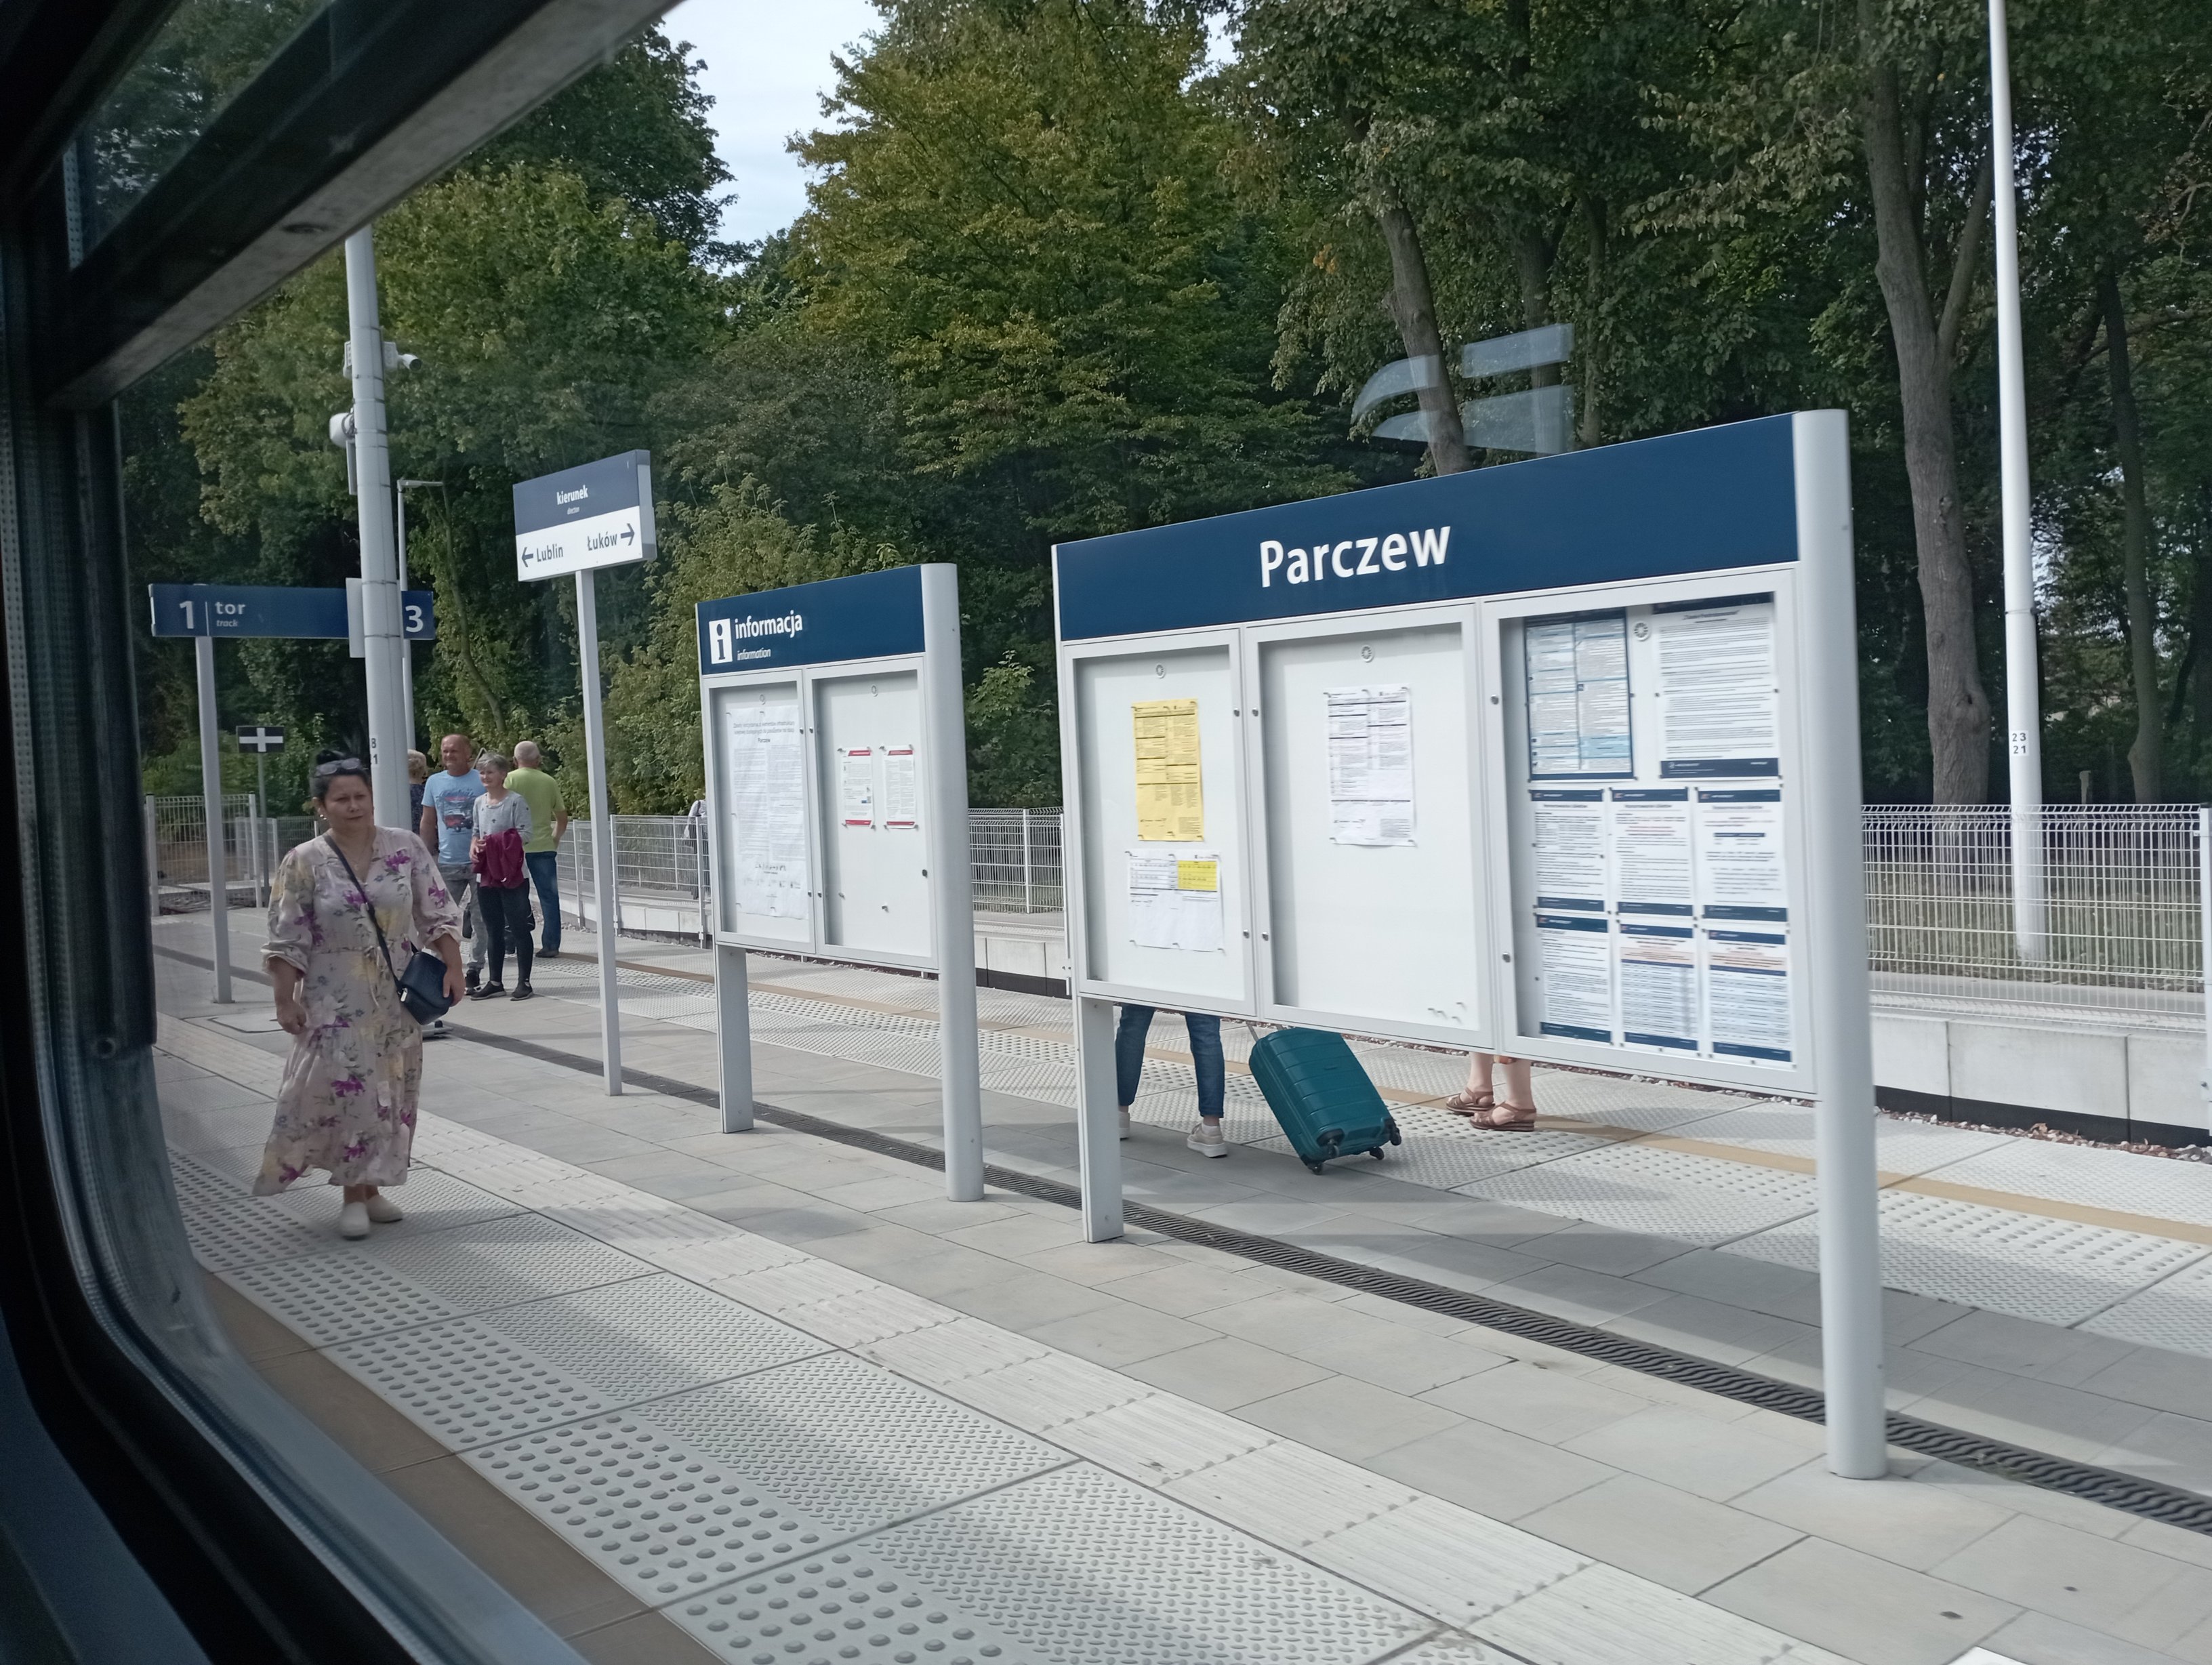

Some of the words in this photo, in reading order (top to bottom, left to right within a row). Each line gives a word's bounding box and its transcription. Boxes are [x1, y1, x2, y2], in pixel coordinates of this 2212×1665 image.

[556, 485, 588, 505] kierunek
[536, 543, 564, 562] Lublin
[587, 532, 617, 551] Łuków
[1260, 526, 1451, 588] Parczew
[179, 600, 195, 629] 1
[215, 601, 246, 615] tor
[216, 619, 238, 628] track
[405, 605, 424, 633] 3
[735, 609, 803, 640] informacja
[737, 647, 771, 661] information
[2011, 733, 2026, 742] 23
[2013, 745, 2026, 754] 21
